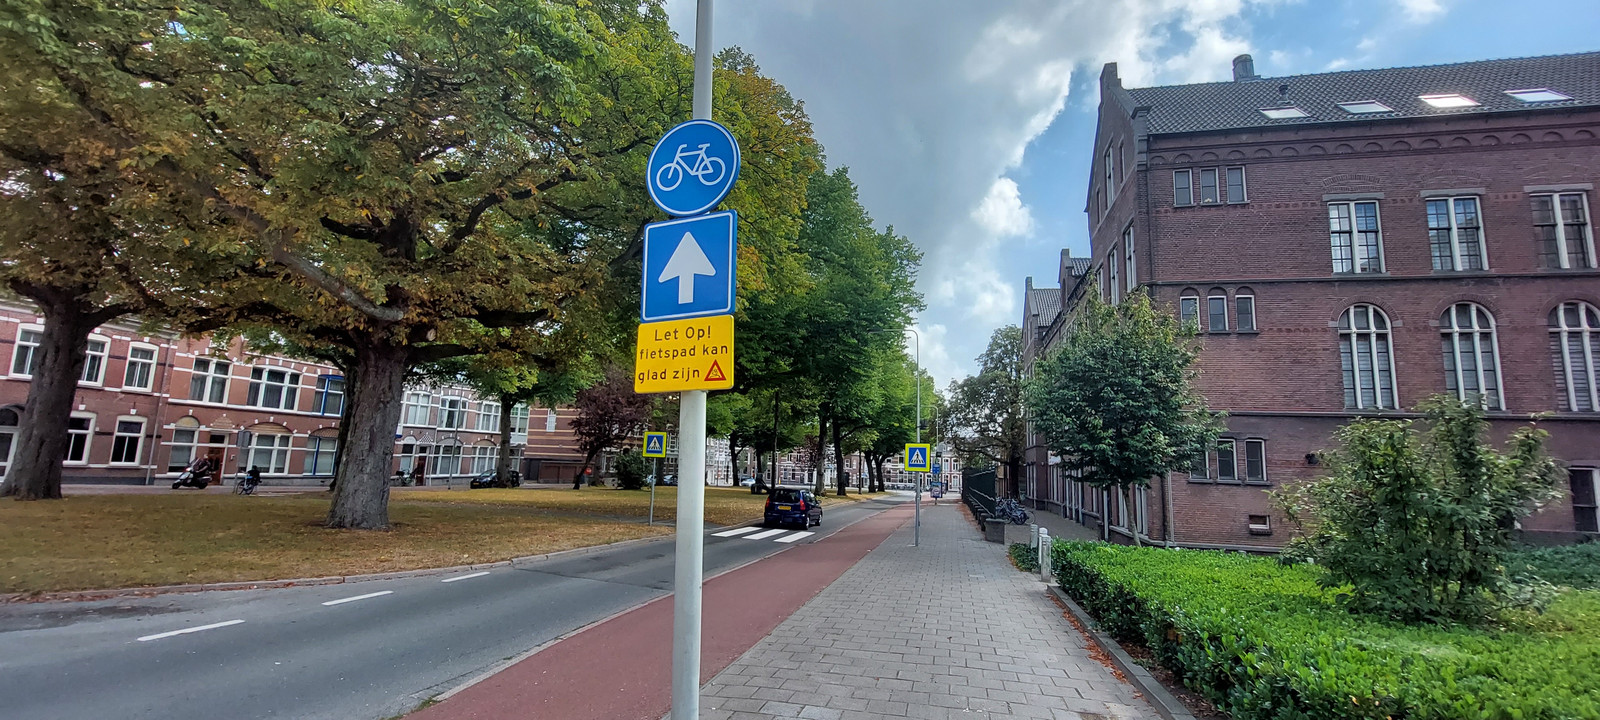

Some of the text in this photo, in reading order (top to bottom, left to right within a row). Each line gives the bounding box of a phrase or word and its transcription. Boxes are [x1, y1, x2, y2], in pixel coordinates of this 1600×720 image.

[654, 325, 711, 341] Let Op!
[640, 344, 728, 360] fietspad kan
[638, 367, 700, 384] glad zijn
